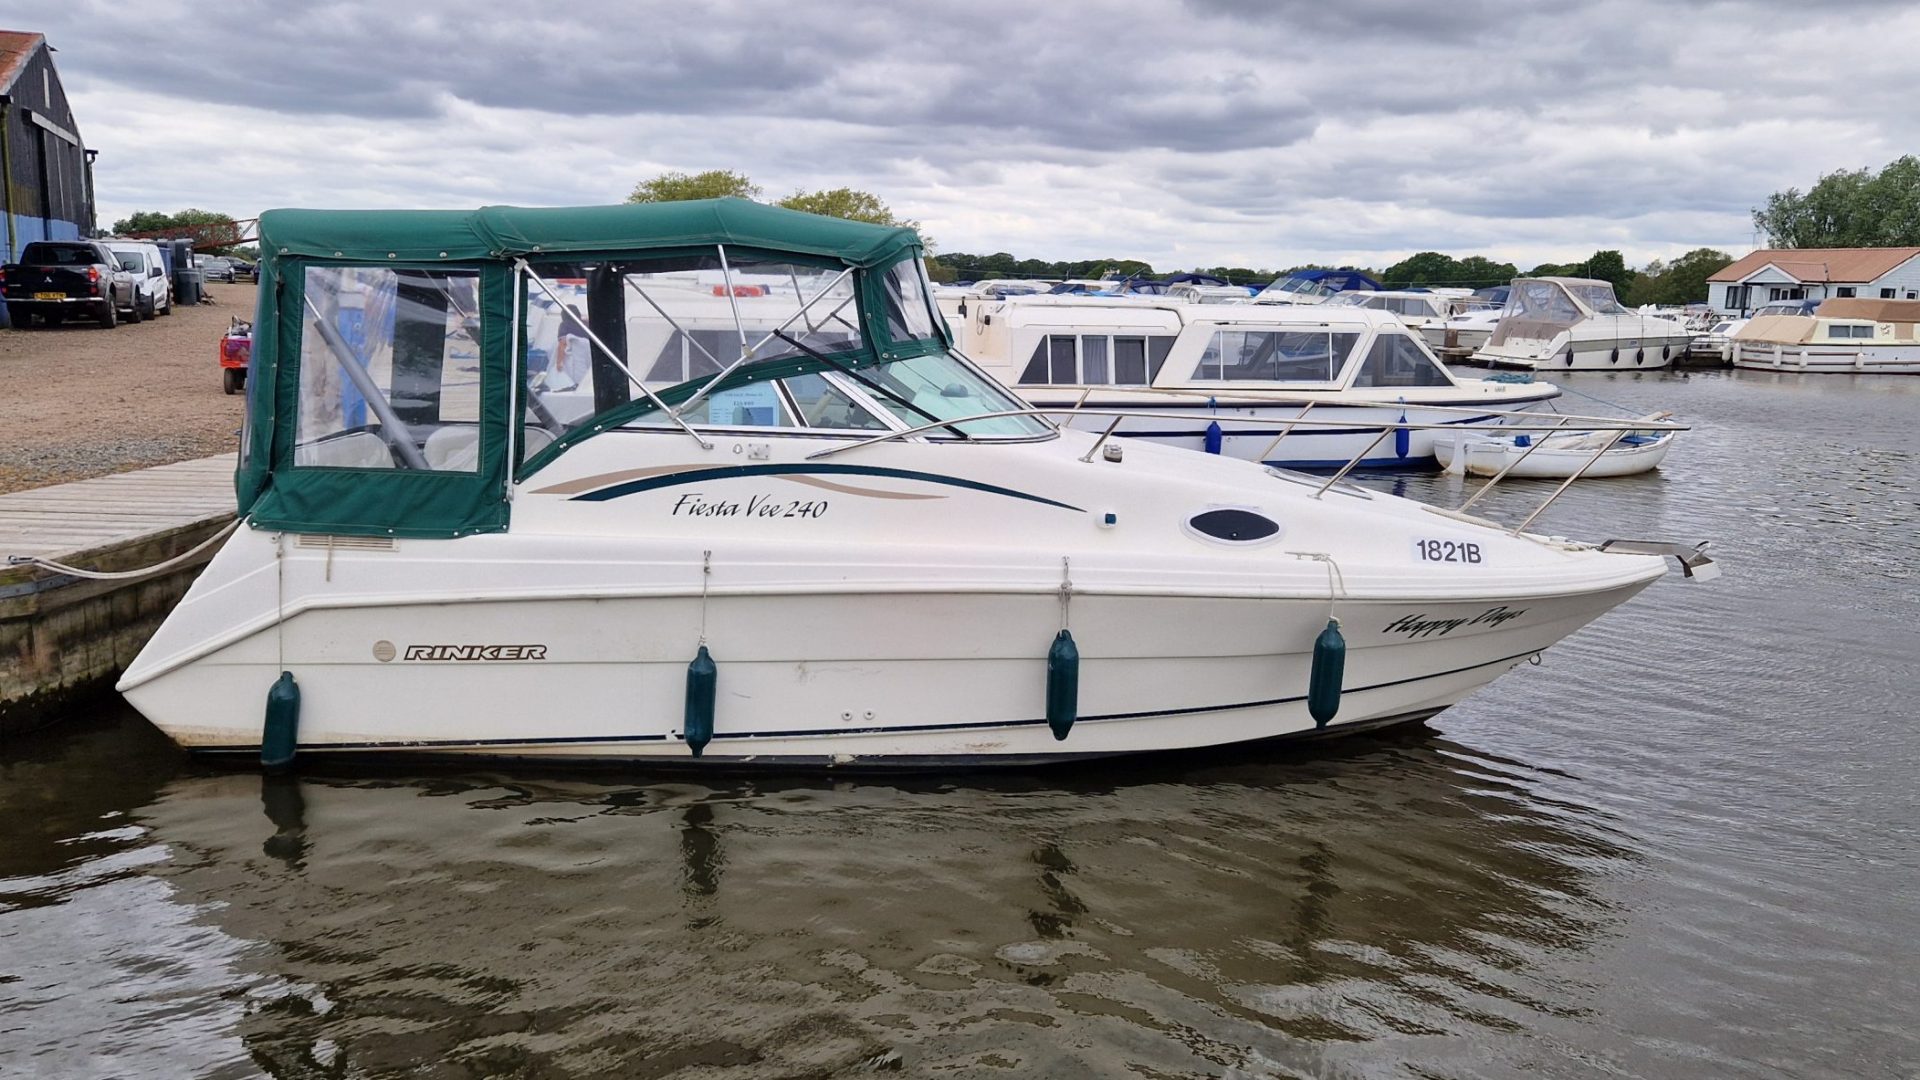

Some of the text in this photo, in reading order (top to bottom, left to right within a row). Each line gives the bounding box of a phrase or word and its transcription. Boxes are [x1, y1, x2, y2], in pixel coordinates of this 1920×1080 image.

[672, 493, 828, 519] Fiesta Vee 240
[1416, 539, 1482, 564] 1821B
[1382, 613, 1470, 639] Happy
[404, 644, 547, 661] RINKER
